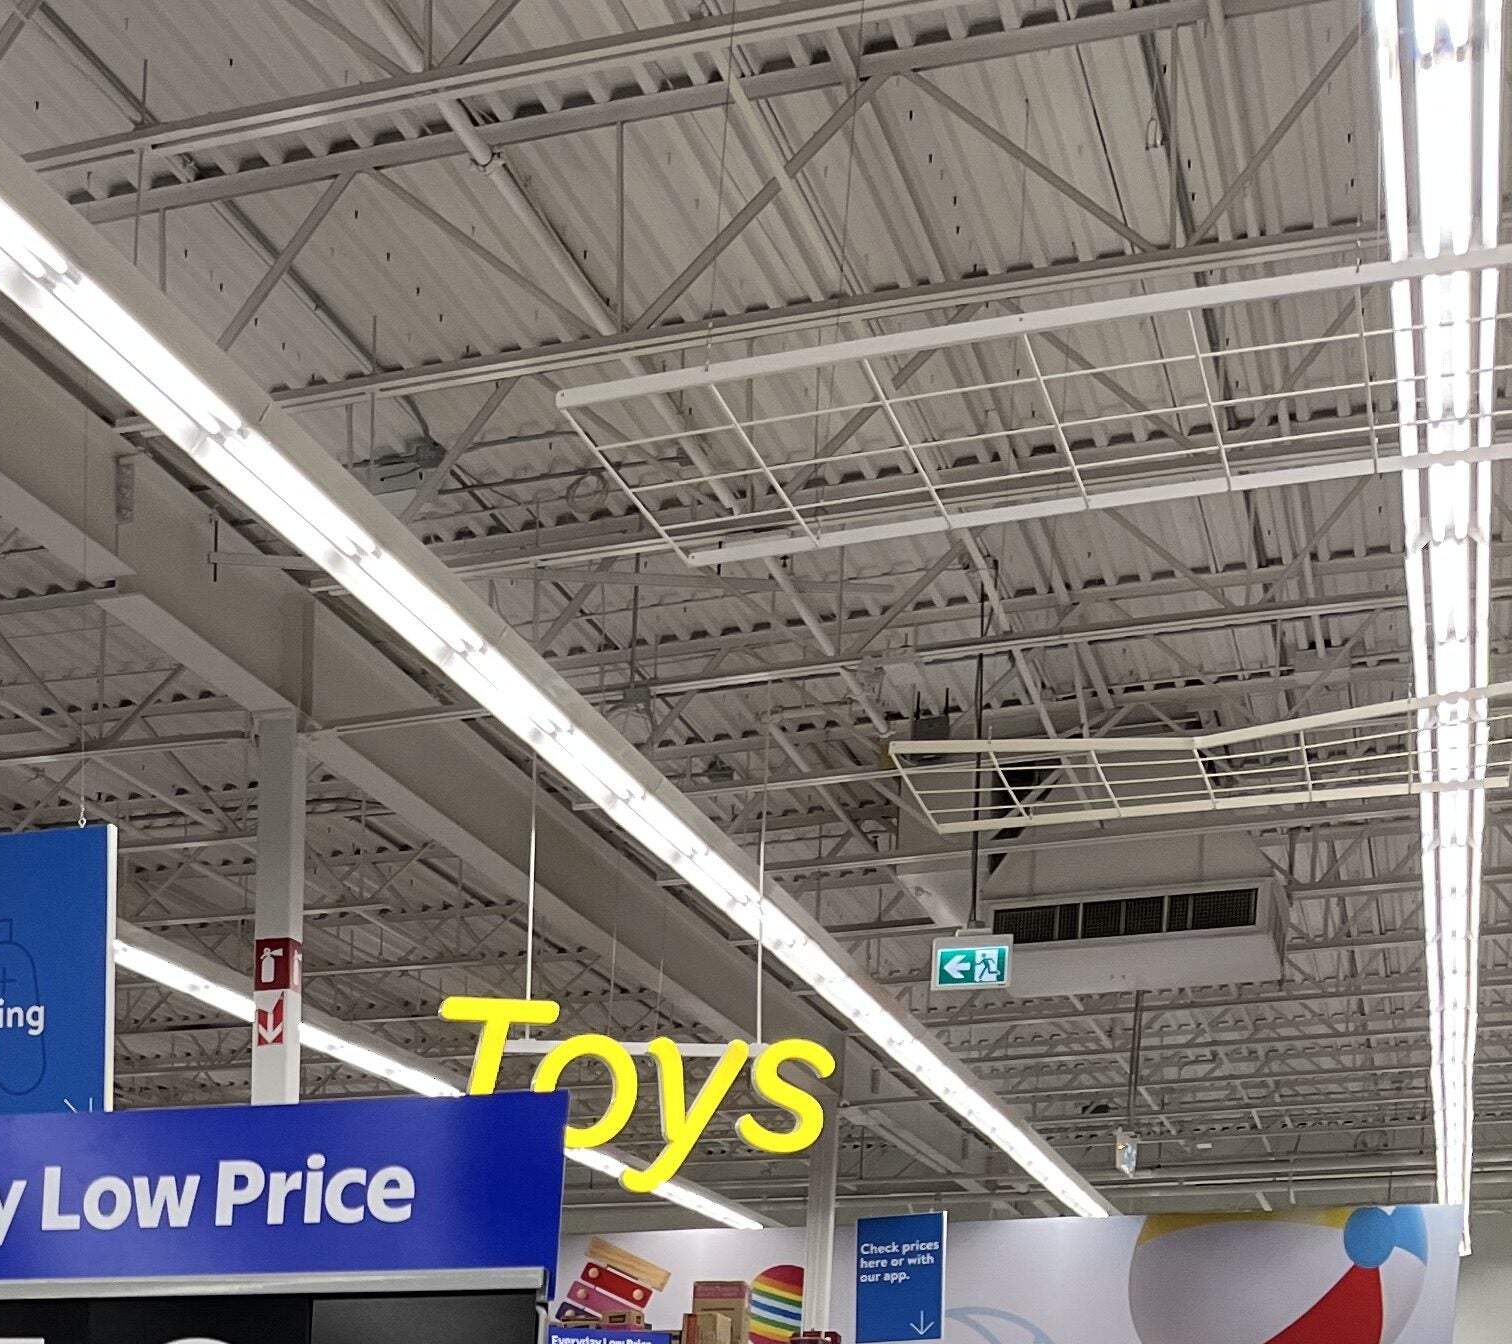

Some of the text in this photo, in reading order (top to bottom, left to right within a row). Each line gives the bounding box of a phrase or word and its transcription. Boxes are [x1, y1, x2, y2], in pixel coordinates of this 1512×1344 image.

[439, 996, 836, 1193] Toys
[40, 1163, 201, 1234] Low
[215, 1152, 417, 1228] Price
[859, 1239, 940, 1256] Check prices
[859, 1253, 935, 1269] here or with
[859, 1271, 910, 1284] our app.
